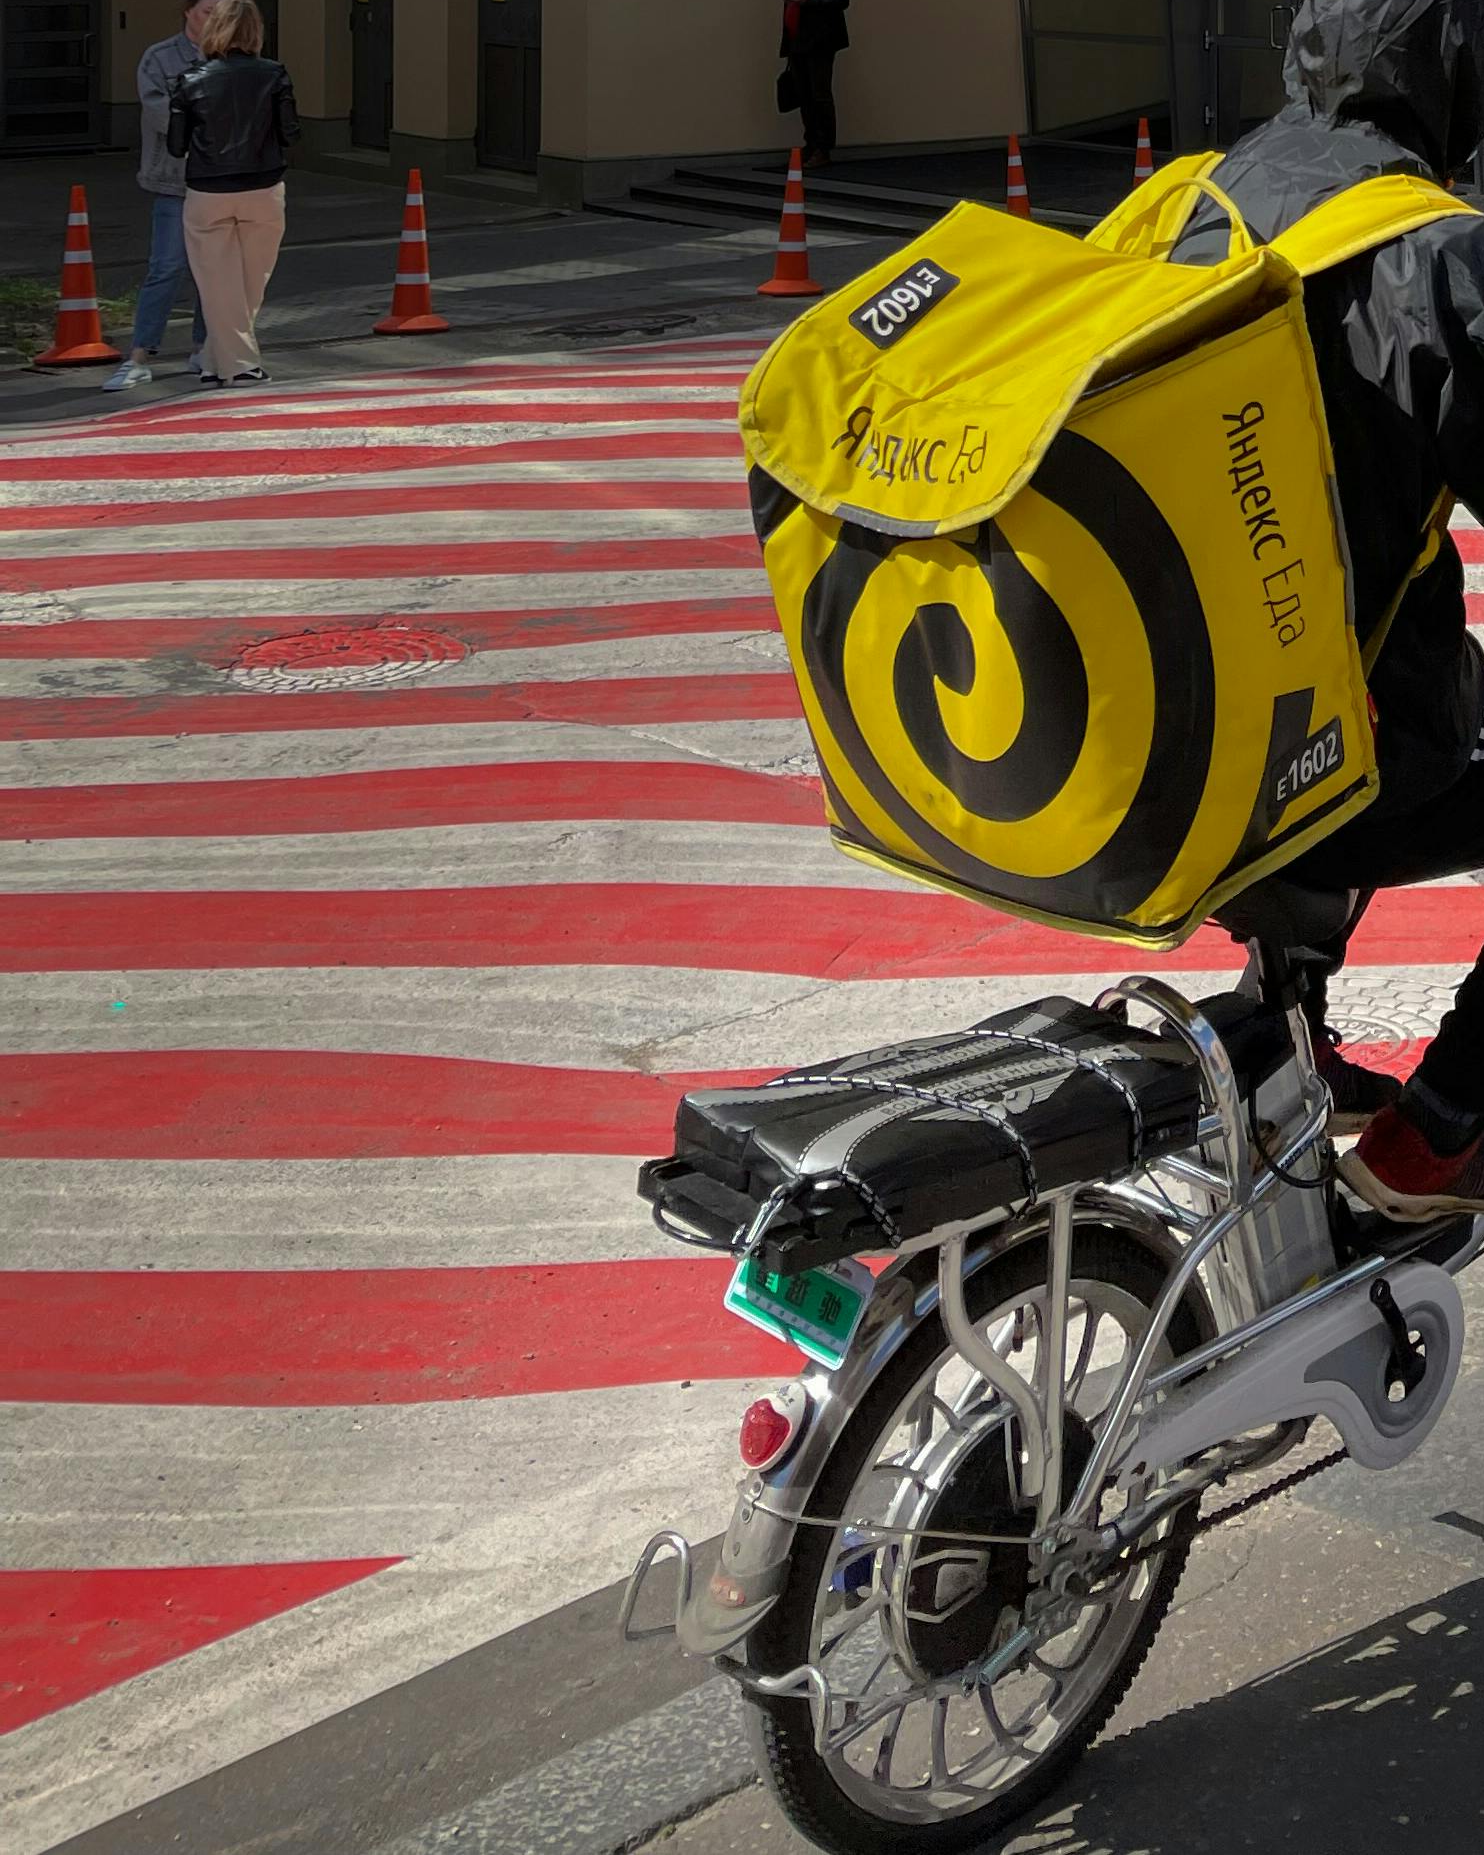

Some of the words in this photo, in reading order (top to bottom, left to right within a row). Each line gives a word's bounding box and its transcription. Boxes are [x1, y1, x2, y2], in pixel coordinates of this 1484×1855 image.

[860, 267, 941, 336] E1602
[1222, 401, 1286, 561] Яндекс
[1262, 558, 1306, 649] Еда
[1276, 731, 1339, 802] E1602
